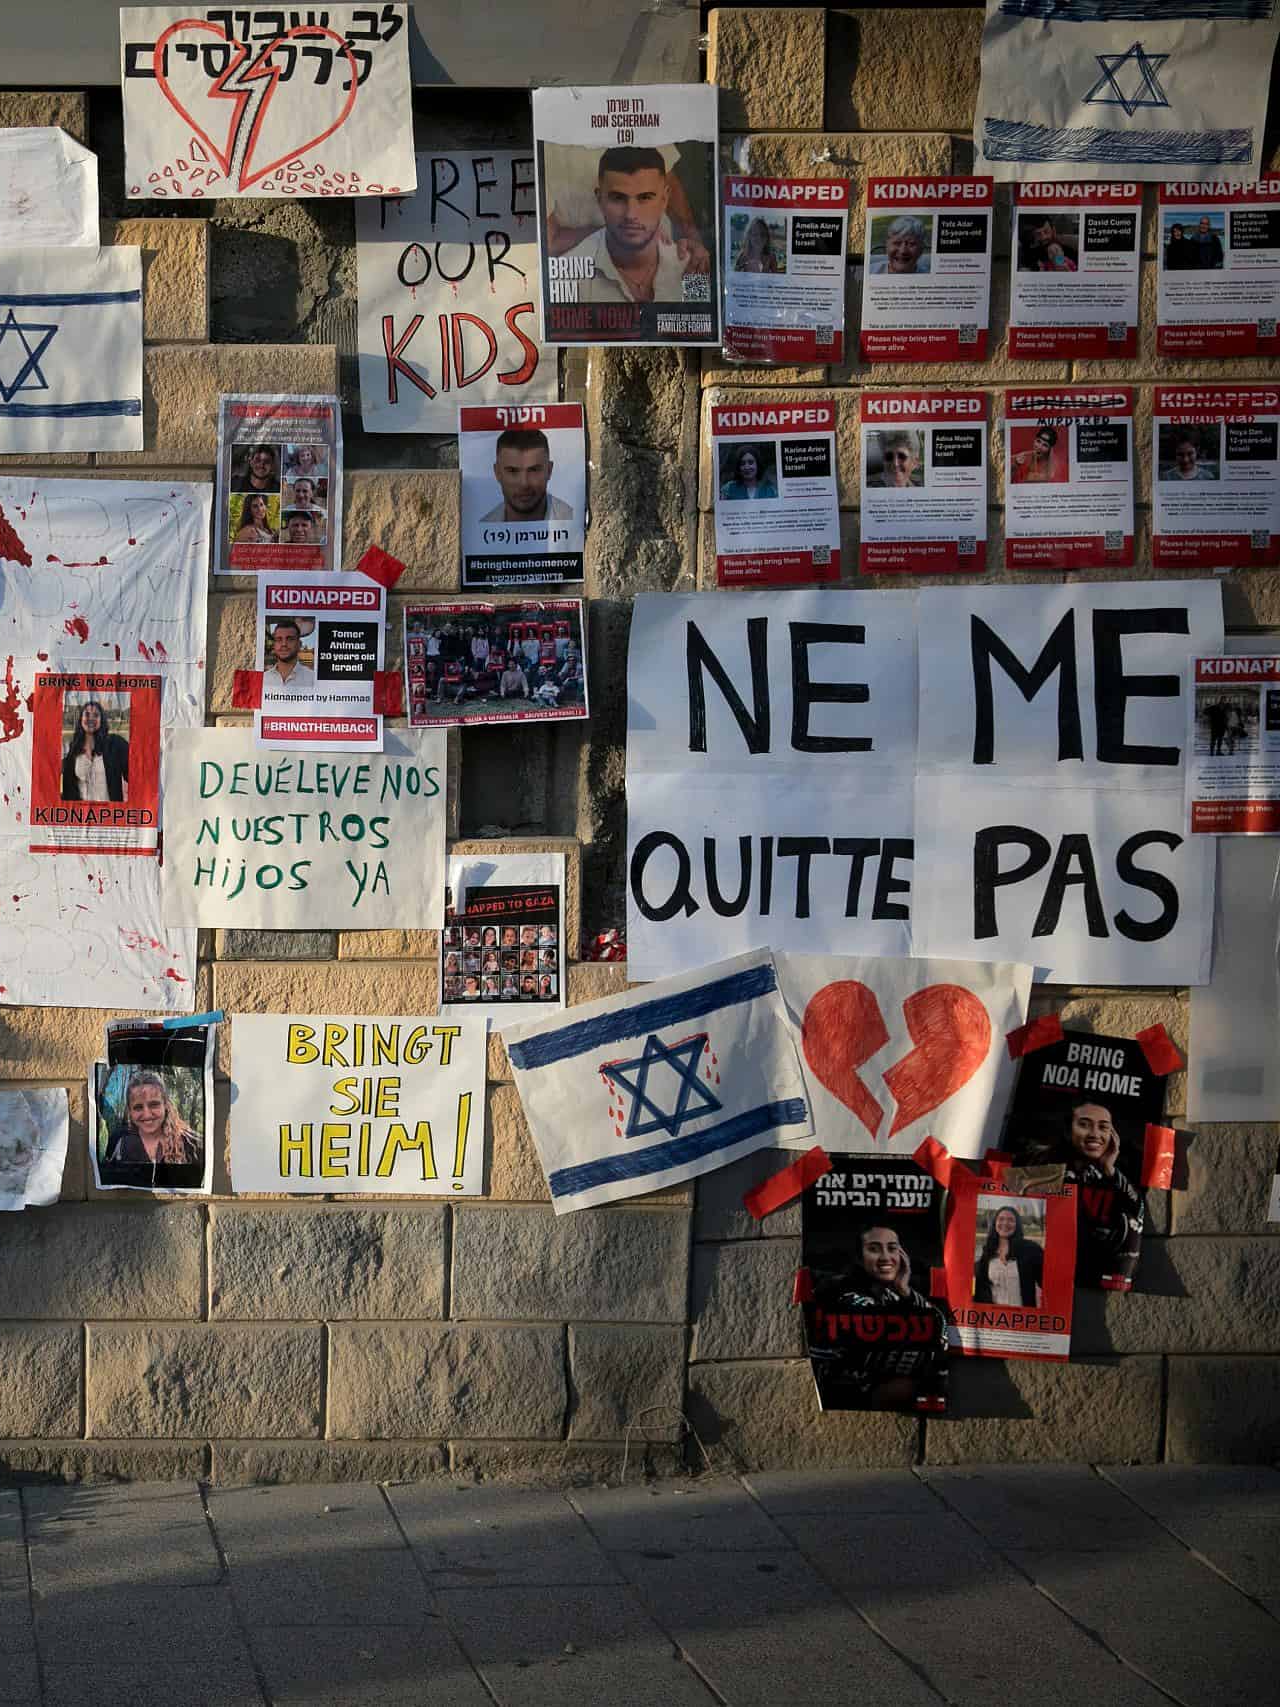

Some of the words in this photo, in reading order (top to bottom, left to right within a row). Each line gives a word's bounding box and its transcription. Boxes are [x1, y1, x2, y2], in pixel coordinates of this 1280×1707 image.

[206, 10, 330, 43] שבור
[345, 4, 404, 43] לב
[591, 116, 609, 129] RON
[611, 115, 660, 128] SCHERMAN
[731, 183, 844, 200] KIDNAPPED
[874, 183, 988, 199] KIDNAPPED
[1020, 183, 1136, 198] KIDNAPPED
[1166, 179, 1280, 197] KIDNAPPED
[397, 231, 526, 289] OUR
[549, 257, 596, 280] BRING
[549, 280, 580, 303] HIM
[382, 303, 539, 404] KIDS
[867, 399, 981, 416] KIDNAPPED
[1161, 393, 1278, 408] KIDNAPPED
[496, 407, 545, 427] חטוף
[718, 409, 829, 427] KIDNAPPED
[1037, 415, 1110, 427] MURDERED
[516, 531, 549, 544] שרמן
[554, 529, 569, 545] רון
[470, 559, 578, 571] #bringthemhomenow
[271, 589, 376, 606] KIDNAPPED
[1200, 660, 1280, 675] KIDNAP
[38, 676, 81, 689] BRING
[85, 677, 115, 688] NOA
[118, 678, 159, 689] HOME
[686, 616, 873, 755] NE
[970, 607, 1191, 767] ME
[264, 692, 314, 703] Kidnapped
[316, 694, 327, 704] by
[264, 721, 374, 735] #BRINGTHEMBACK
[35, 806, 154, 826] KIDNAPPED
[196, 811, 390, 849] NUESTROS
[345, 860, 390, 908] YA
[630, 830, 915, 922] QUITTE
[973, 825, 1185, 943] PAS
[524, 895, 555, 908] GAZA
[286, 1023, 462, 1067] BRINGT
[1067, 1042, 1125, 1069] BRING
[1042, 1063, 1080, 1088] NOA
[1084, 1070, 1143, 1097] HOME
[329, 1076, 401, 1118] SIE
[279, 1092, 473, 1190] HEIM!
[853, 1174, 934, 1190] מחזירים
[816, 1191, 882, 1207] הביתה
[887, 1193, 931, 1208] נועה
[948, 1308, 1066, 1332] KIDNAPPED
